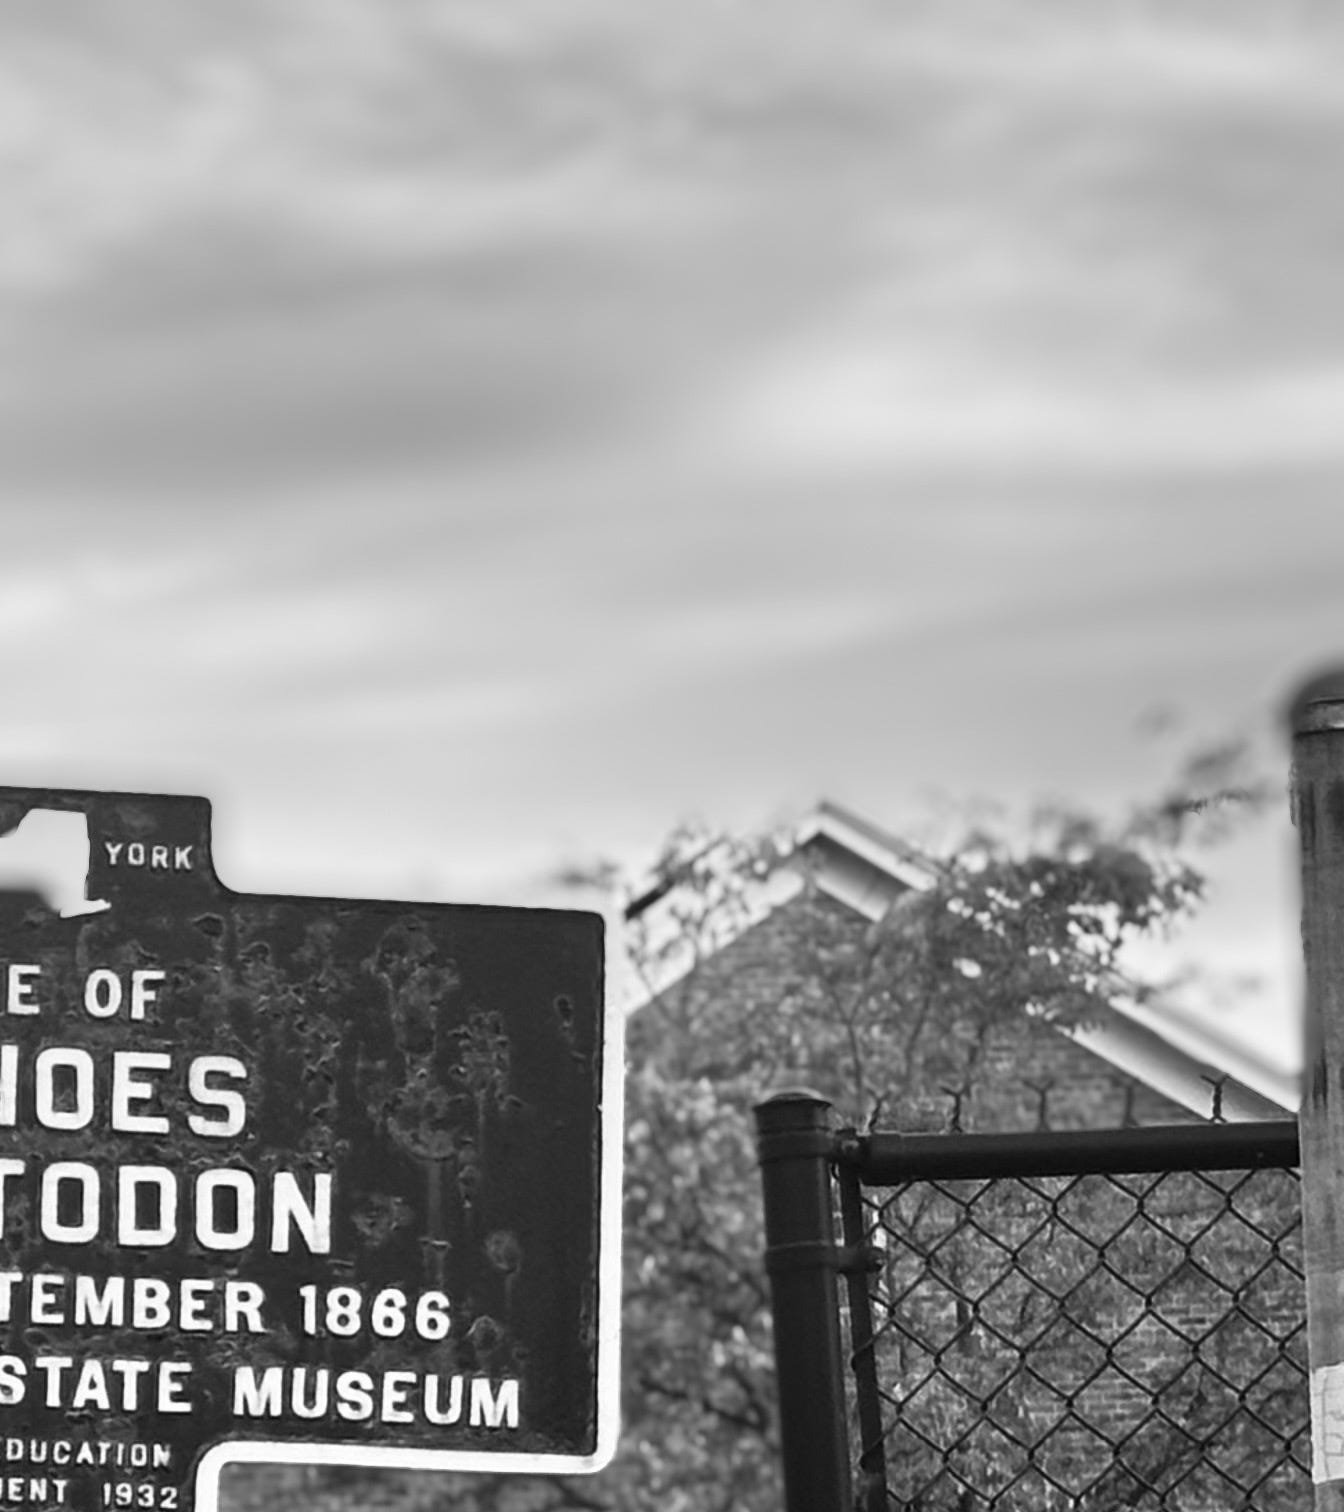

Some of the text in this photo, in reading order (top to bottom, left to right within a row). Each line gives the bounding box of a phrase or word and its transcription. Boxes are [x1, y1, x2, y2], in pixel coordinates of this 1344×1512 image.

[105, 843, 193, 869] YORK
[84, 969, 165, 1020] OF
[299, 1285, 451, 1340] 1866
[233, 1366, 519, 1428] MUSEUM
[103, 1482, 177, 1509] 1932
